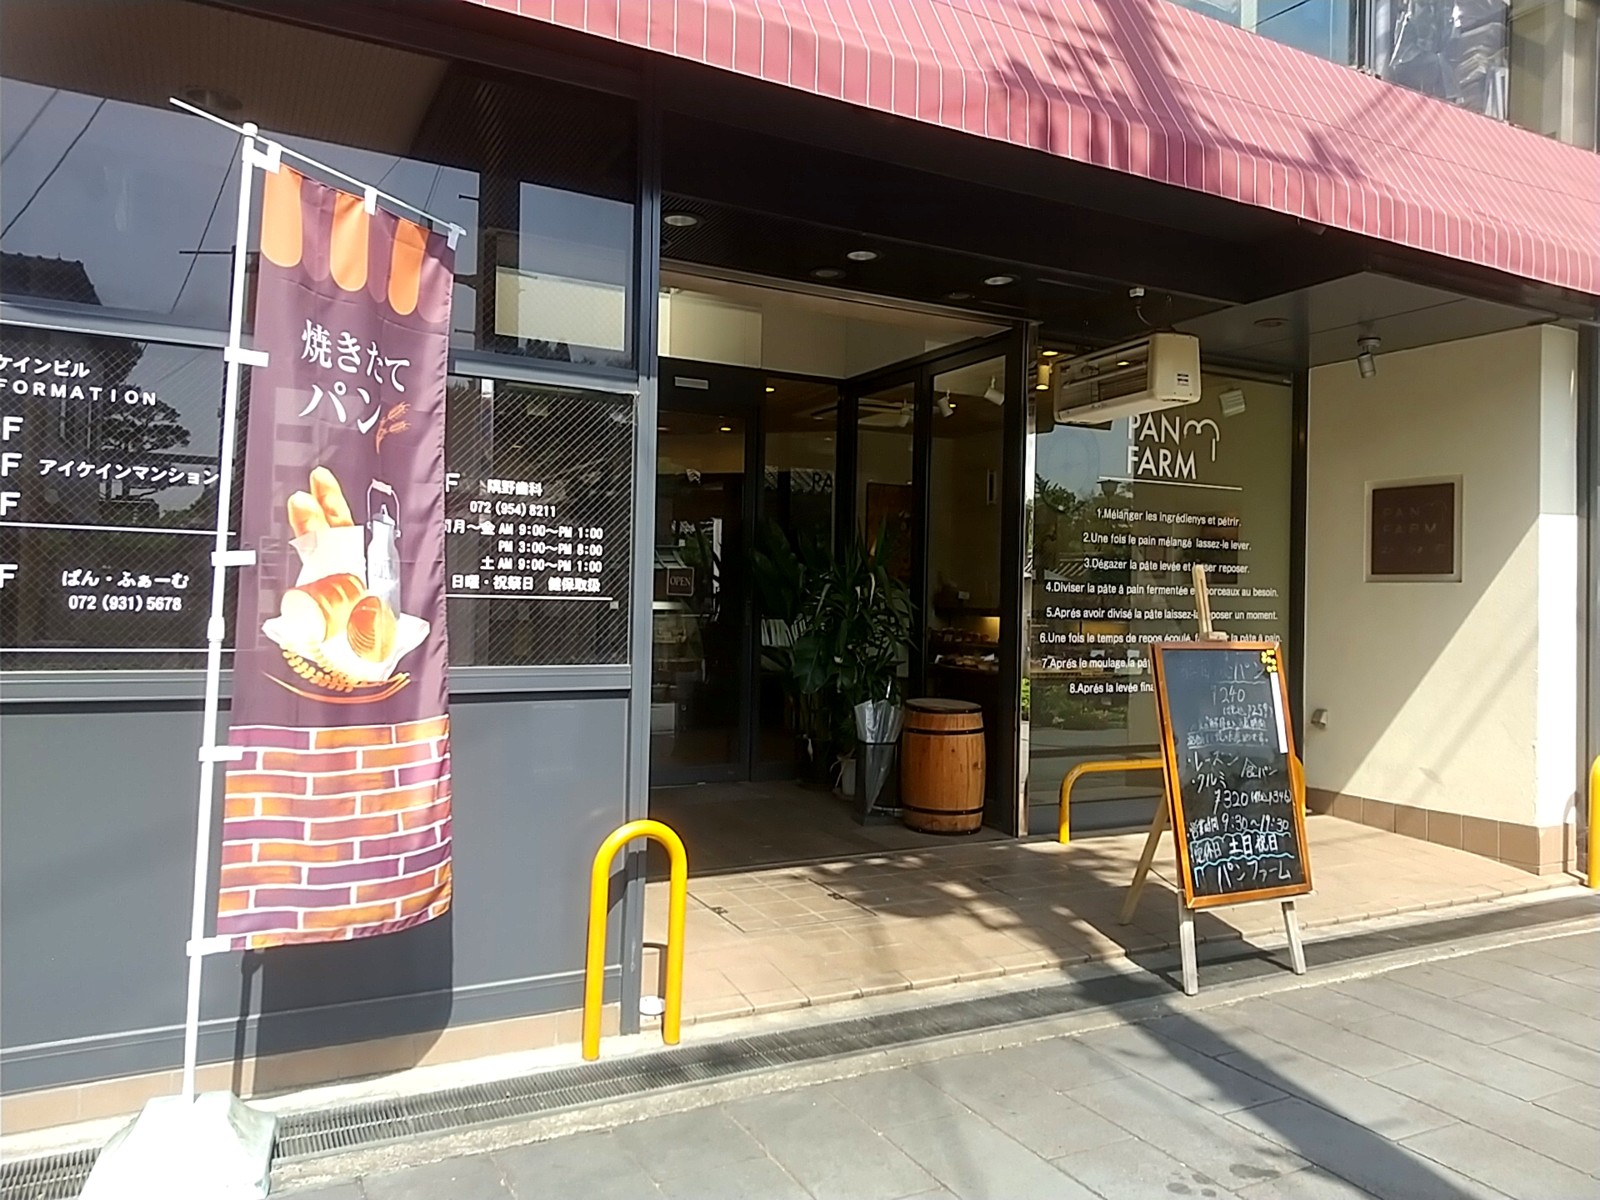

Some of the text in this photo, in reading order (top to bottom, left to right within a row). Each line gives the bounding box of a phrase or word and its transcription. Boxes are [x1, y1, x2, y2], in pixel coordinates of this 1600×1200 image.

[301, 317, 411, 394] 焼きたて
[298, 380, 383, 435] パン
[1127, 413, 1180, 445] PAN
[1127, 445, 1197, 480] FARM
[38, 458, 221, 486] アイケインマンション
[1145, 510, 1157, 522] les
[1207, 515, 1216, 525] et
[1082, 532, 1109, 543] 2.Une
[1111, 533, 1126, 544] fois
[1128, 534, 1136, 545] le
[1138, 534, 1157, 547] pain
[1231, 540, 1252, 551] lever.
[1129, 559, 1137, 570] la
[1182, 562, 1192, 572] et
[1218, 564, 1250, 575] reposer.
[670, 576, 691, 586] OPEN
[1087, 582, 1095, 593] la
[1126, 583, 1145, 595] pain
[1242, 588, 1251, 597] au
[1252, 586, 1279, 598] besoin.
[1083, 607, 1106, 619] avoir
[1134, 608, 1143, 619] la
[1234, 611, 1245, 620] un
[1246, 610, 1278, 621] moment.
[1039, 632, 1066, 644] 6.Une
[1068, 632, 1085, 644] fois
[1087, 632, 1095, 644] le
[1097, 632, 1124, 645] temps
[1125, 633, 1136, 644] de
[1079, 657, 1088, 668] le
[1106, 682, 1114, 693] la
[1217, 859, 1293, 893] パンファーム
